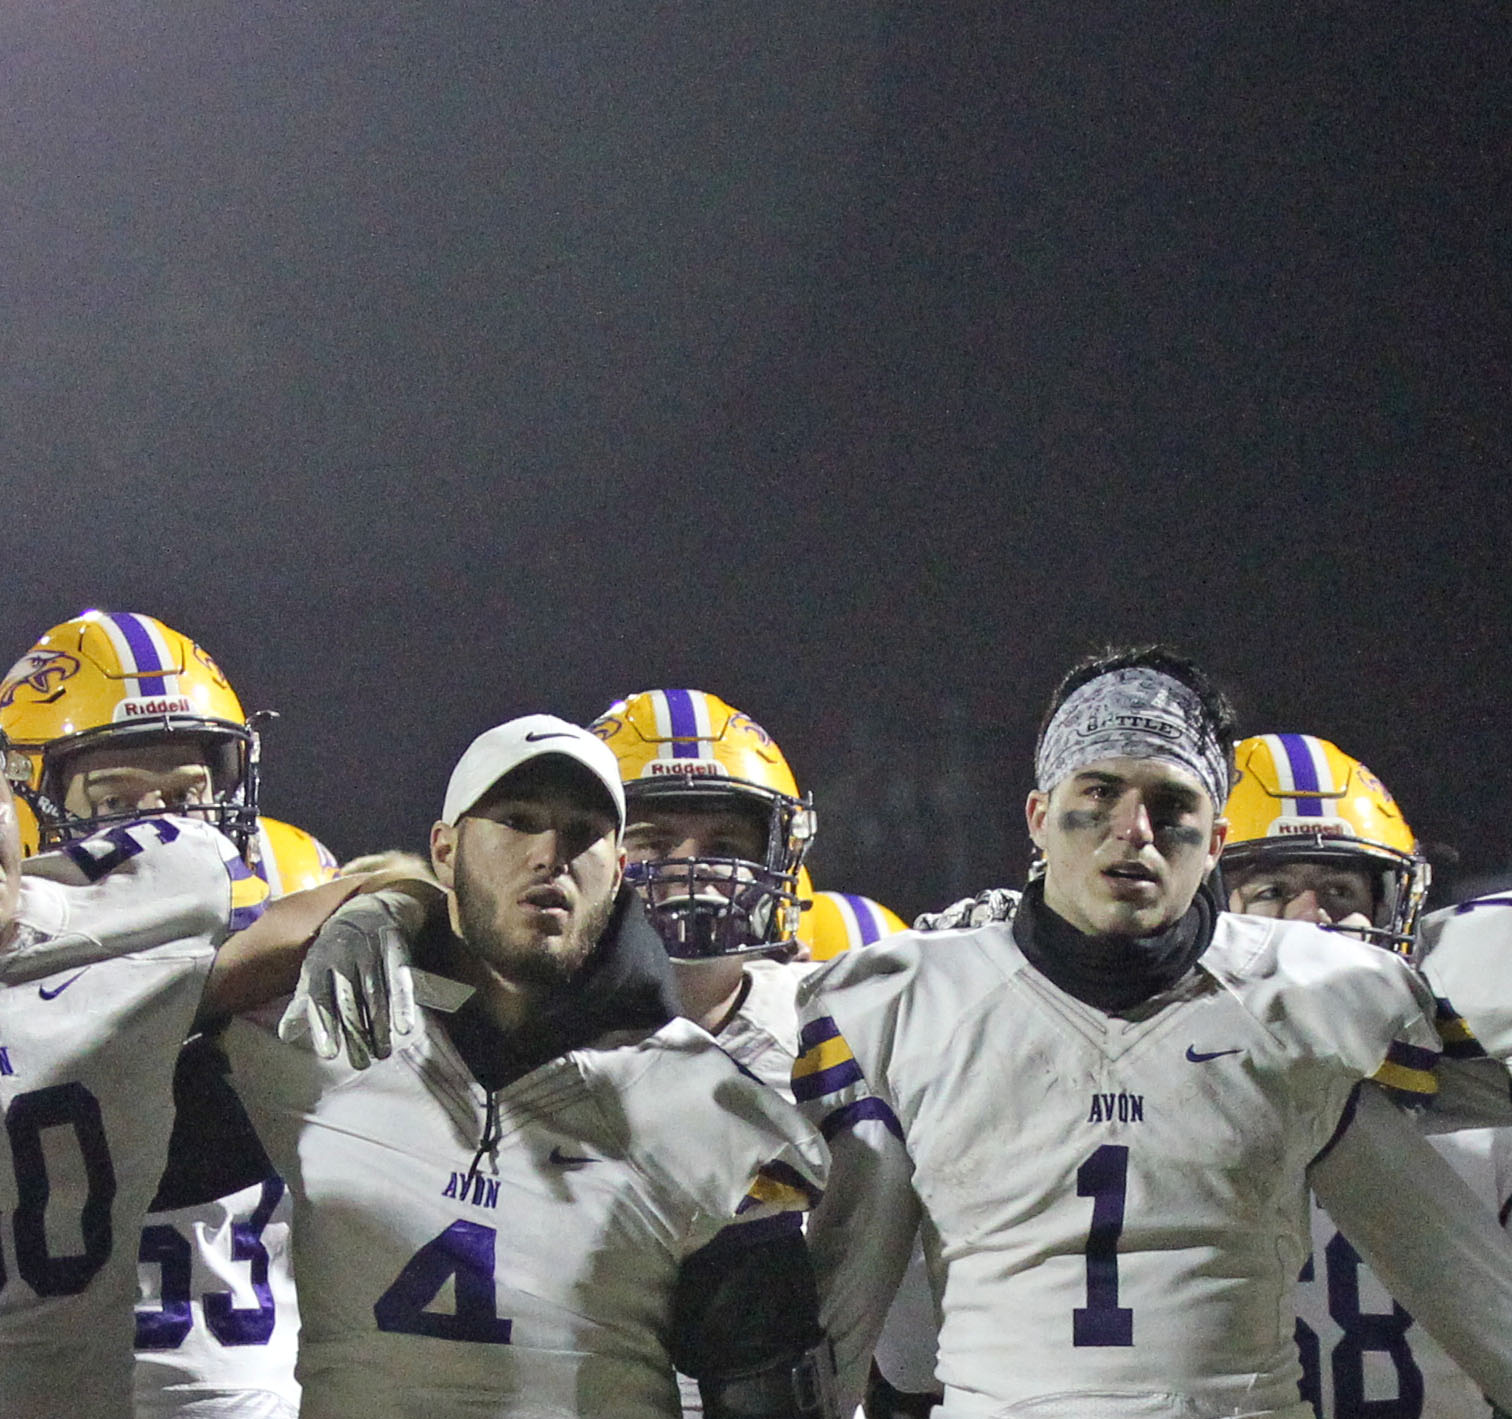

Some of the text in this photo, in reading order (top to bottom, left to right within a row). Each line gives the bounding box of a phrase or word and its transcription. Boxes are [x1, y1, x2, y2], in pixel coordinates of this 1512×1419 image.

[125, 698, 190, 716] Riddell
[651, 762, 717, 775] Riddell
[1087, 1092, 1145, 1123] AVON
[441, 1171, 501, 1209] AVON
[1072, 1145, 1135, 1346] 1
[374, 1218, 513, 1344] 4
